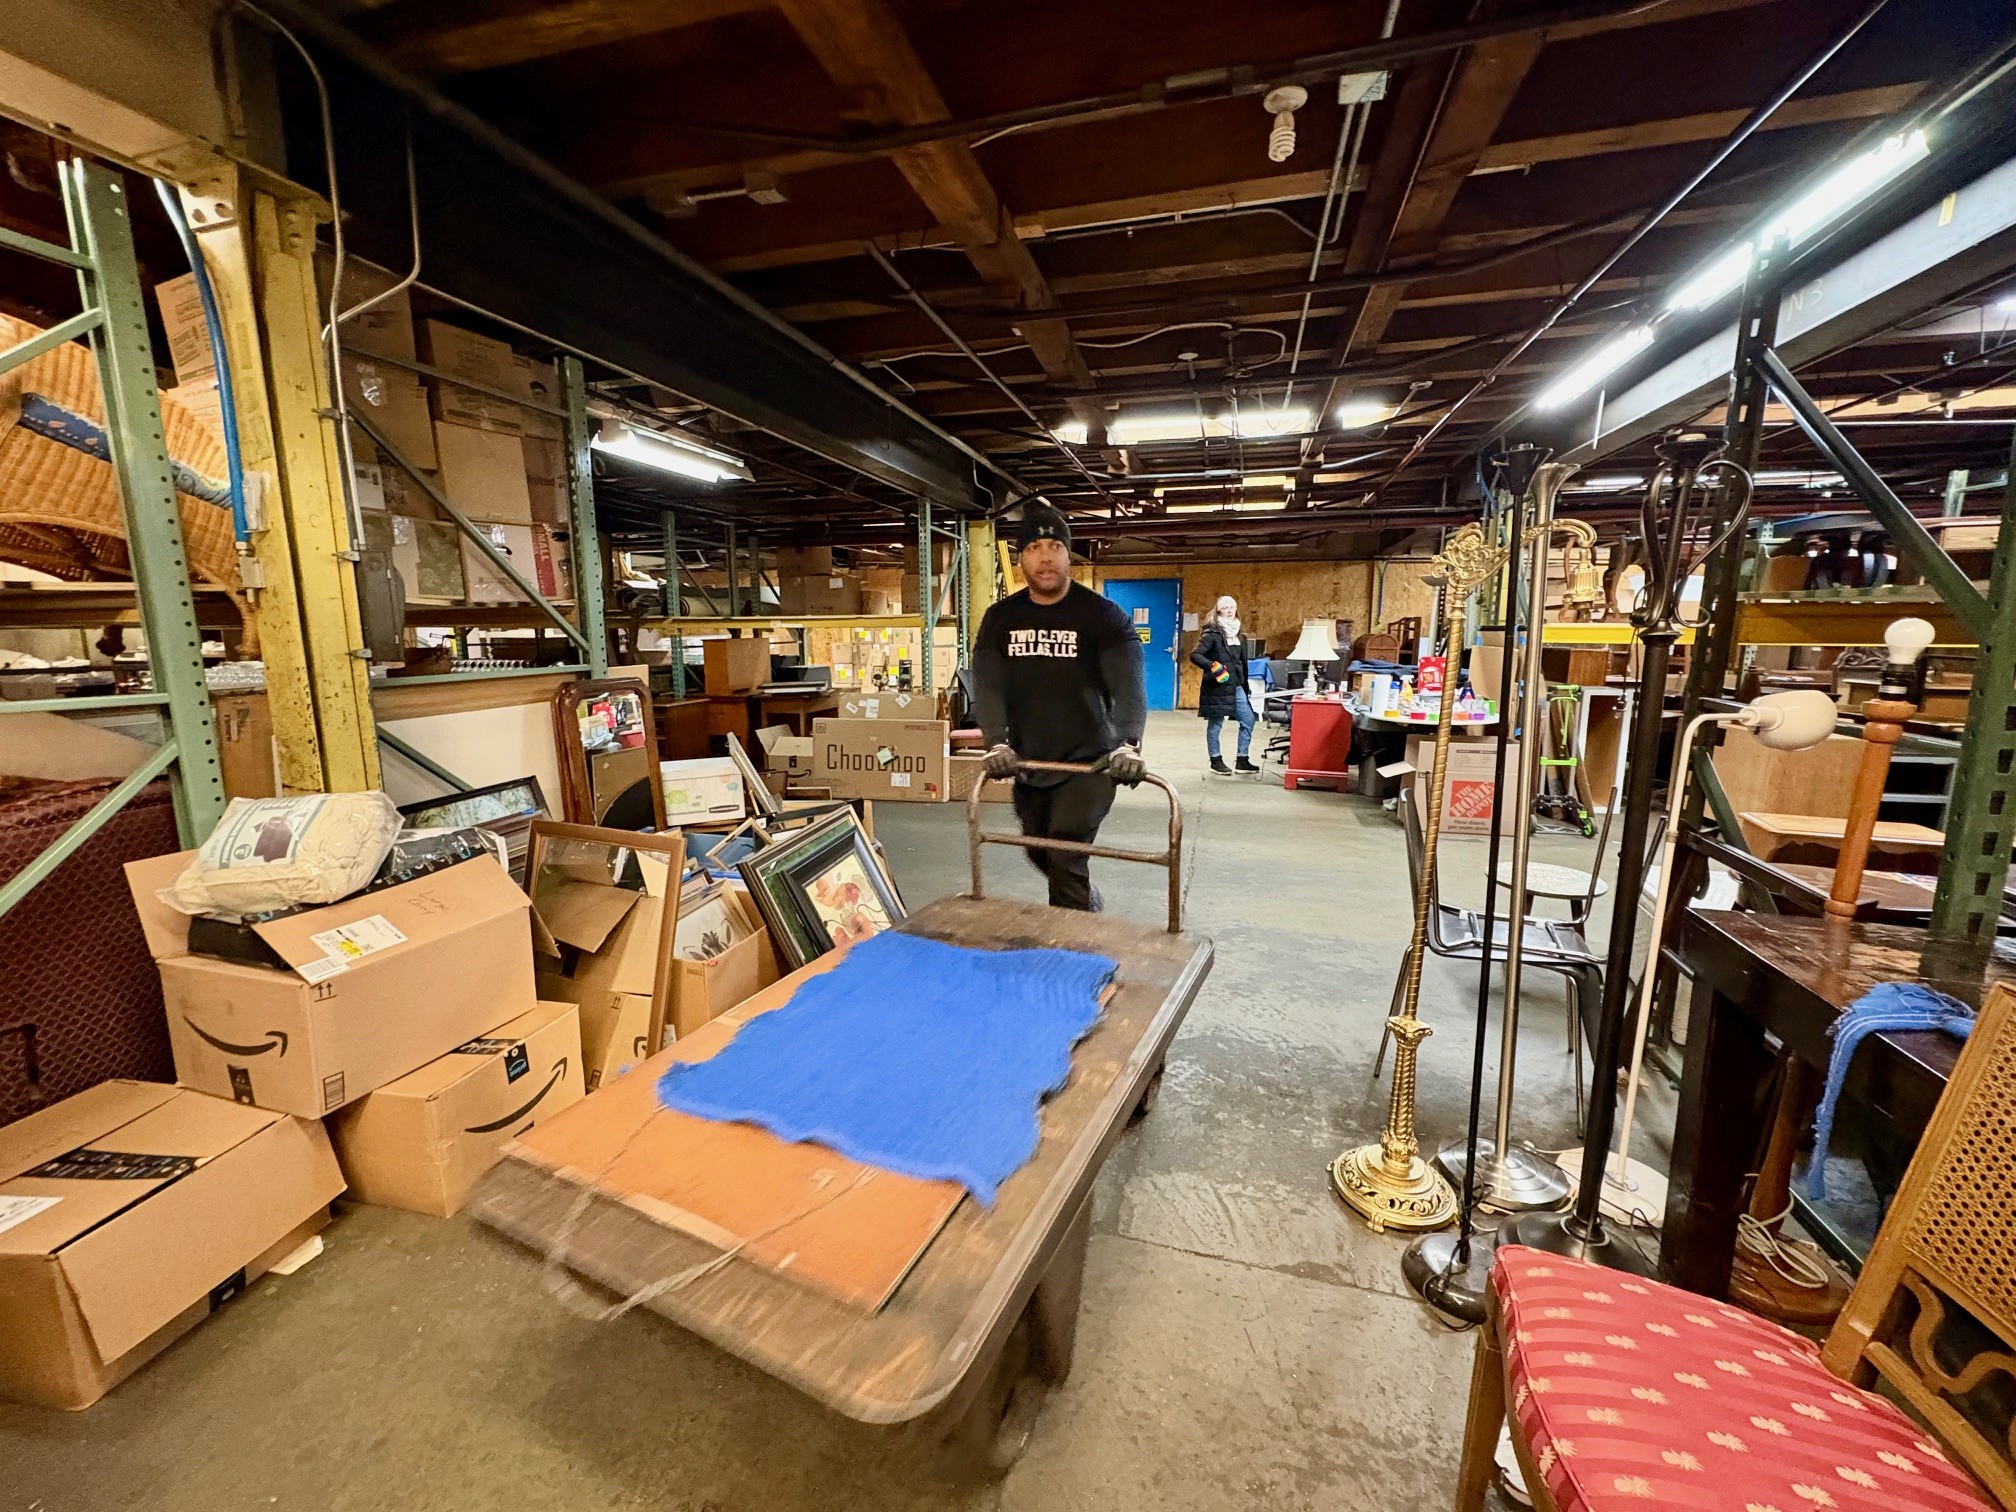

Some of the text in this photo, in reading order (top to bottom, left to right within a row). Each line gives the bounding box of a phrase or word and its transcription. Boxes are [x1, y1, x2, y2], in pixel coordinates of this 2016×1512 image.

[1009, 629, 1078, 644] TWO CLEVER
[1054, 644, 1078, 658] LLC
[1449, 780, 1494, 817] HOME
